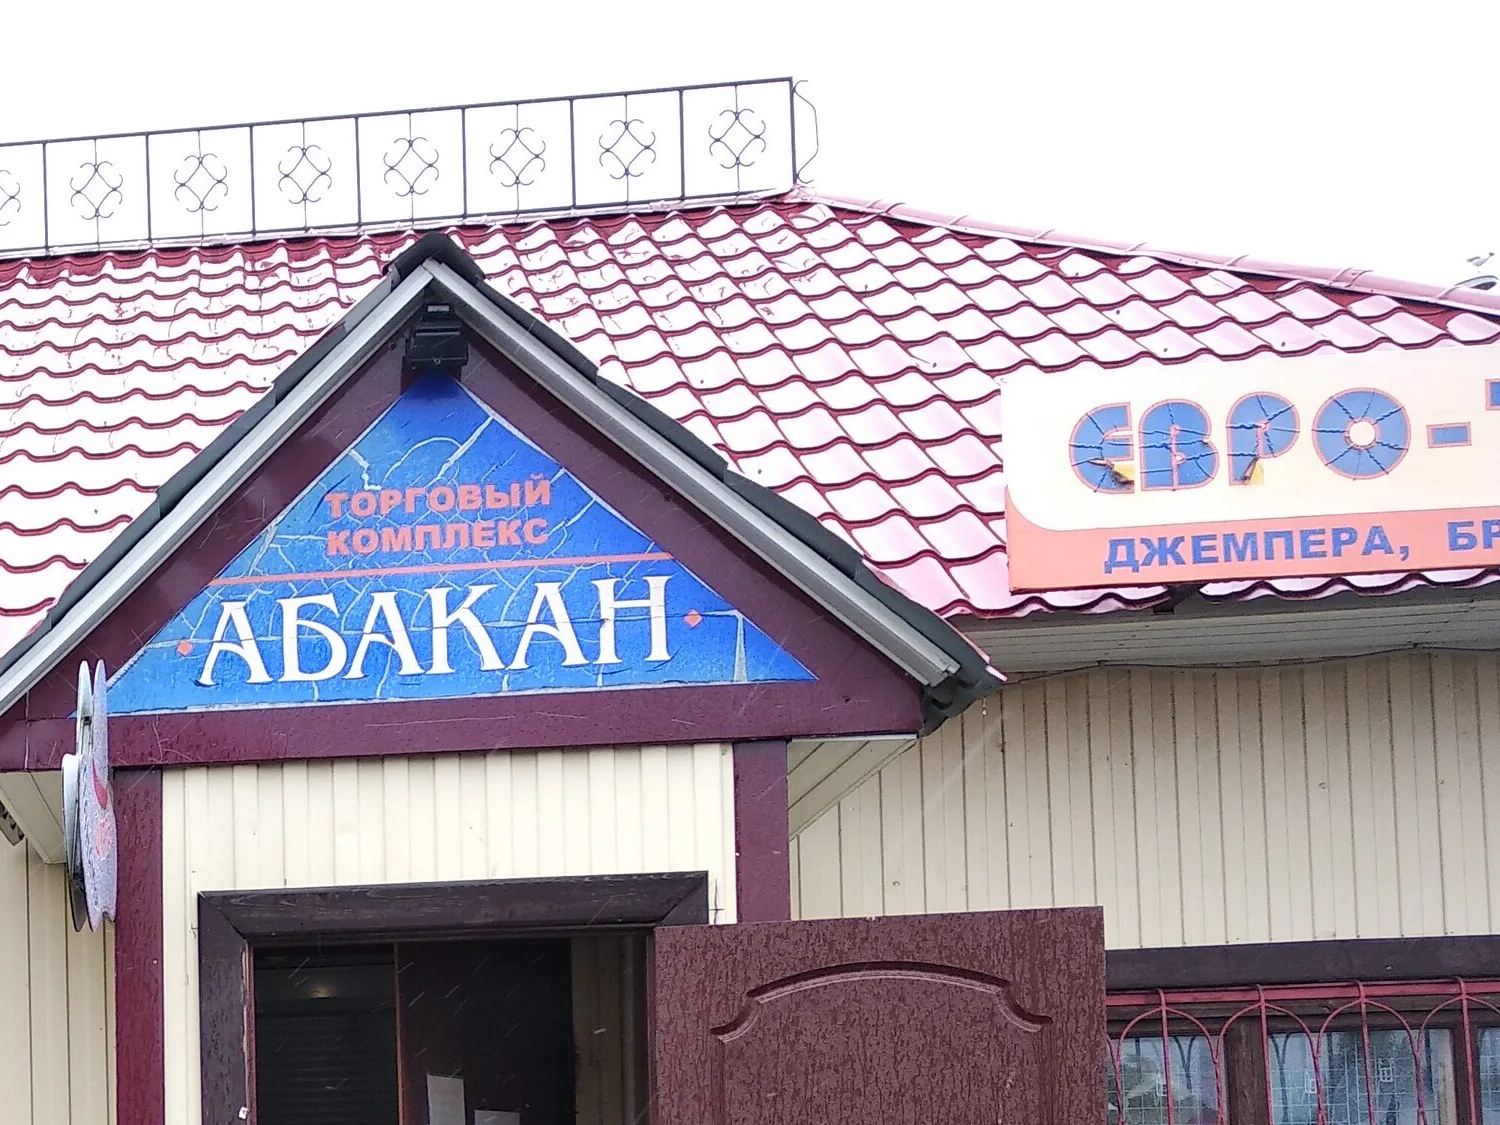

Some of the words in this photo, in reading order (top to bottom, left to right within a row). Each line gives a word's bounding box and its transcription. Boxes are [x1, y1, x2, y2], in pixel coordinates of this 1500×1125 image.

[1070, 379, 1500, 493] ЕВРО-
[325, 480, 551, 518] ТОРГОВЫЙ
[326, 518, 549, 556] КОМПЛЕКС
[1104, 526, 1409, 573] ДЖЕМПЕРА,
[198, 576, 672, 685] АБАКАН
